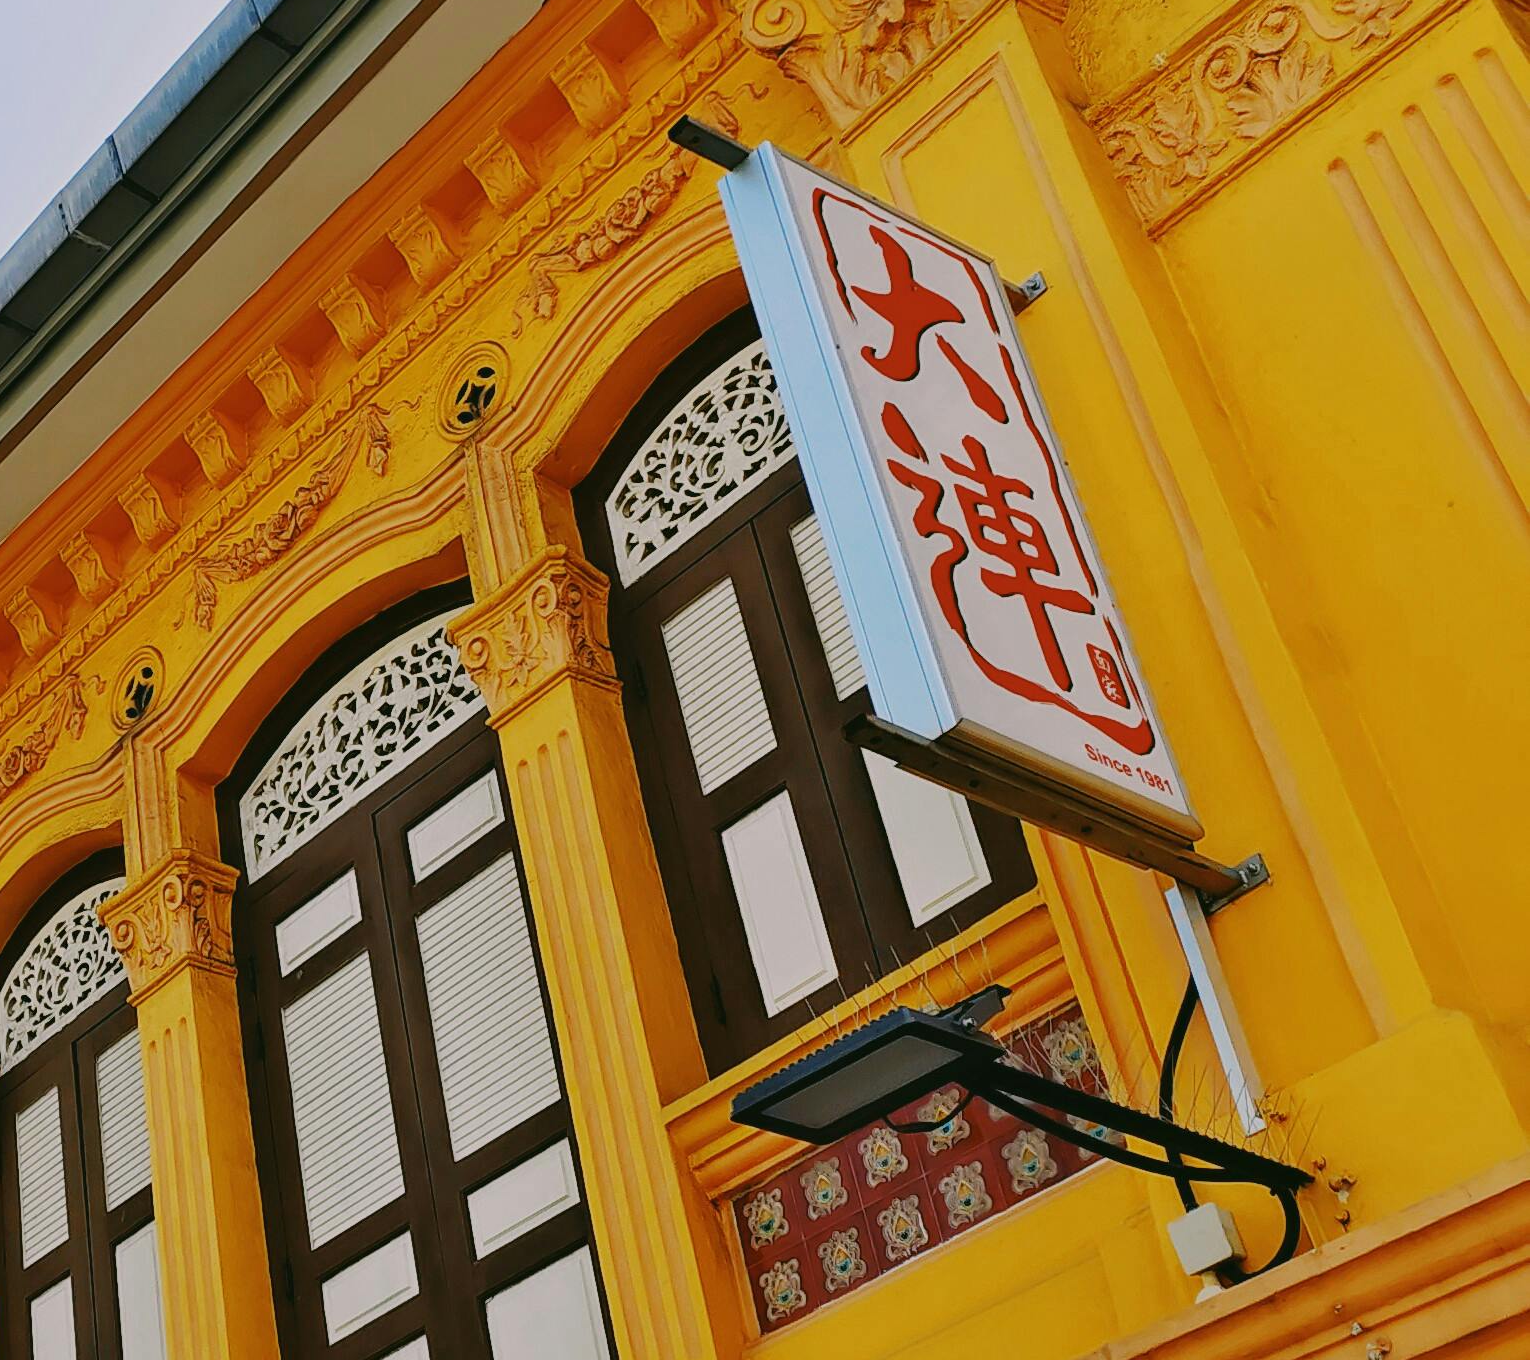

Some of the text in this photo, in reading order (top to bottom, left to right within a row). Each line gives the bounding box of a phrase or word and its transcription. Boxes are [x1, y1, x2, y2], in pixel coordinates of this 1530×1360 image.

[851, 225, 1155, 756] 大連
[1084, 743, 1173, 796] Since 1981
